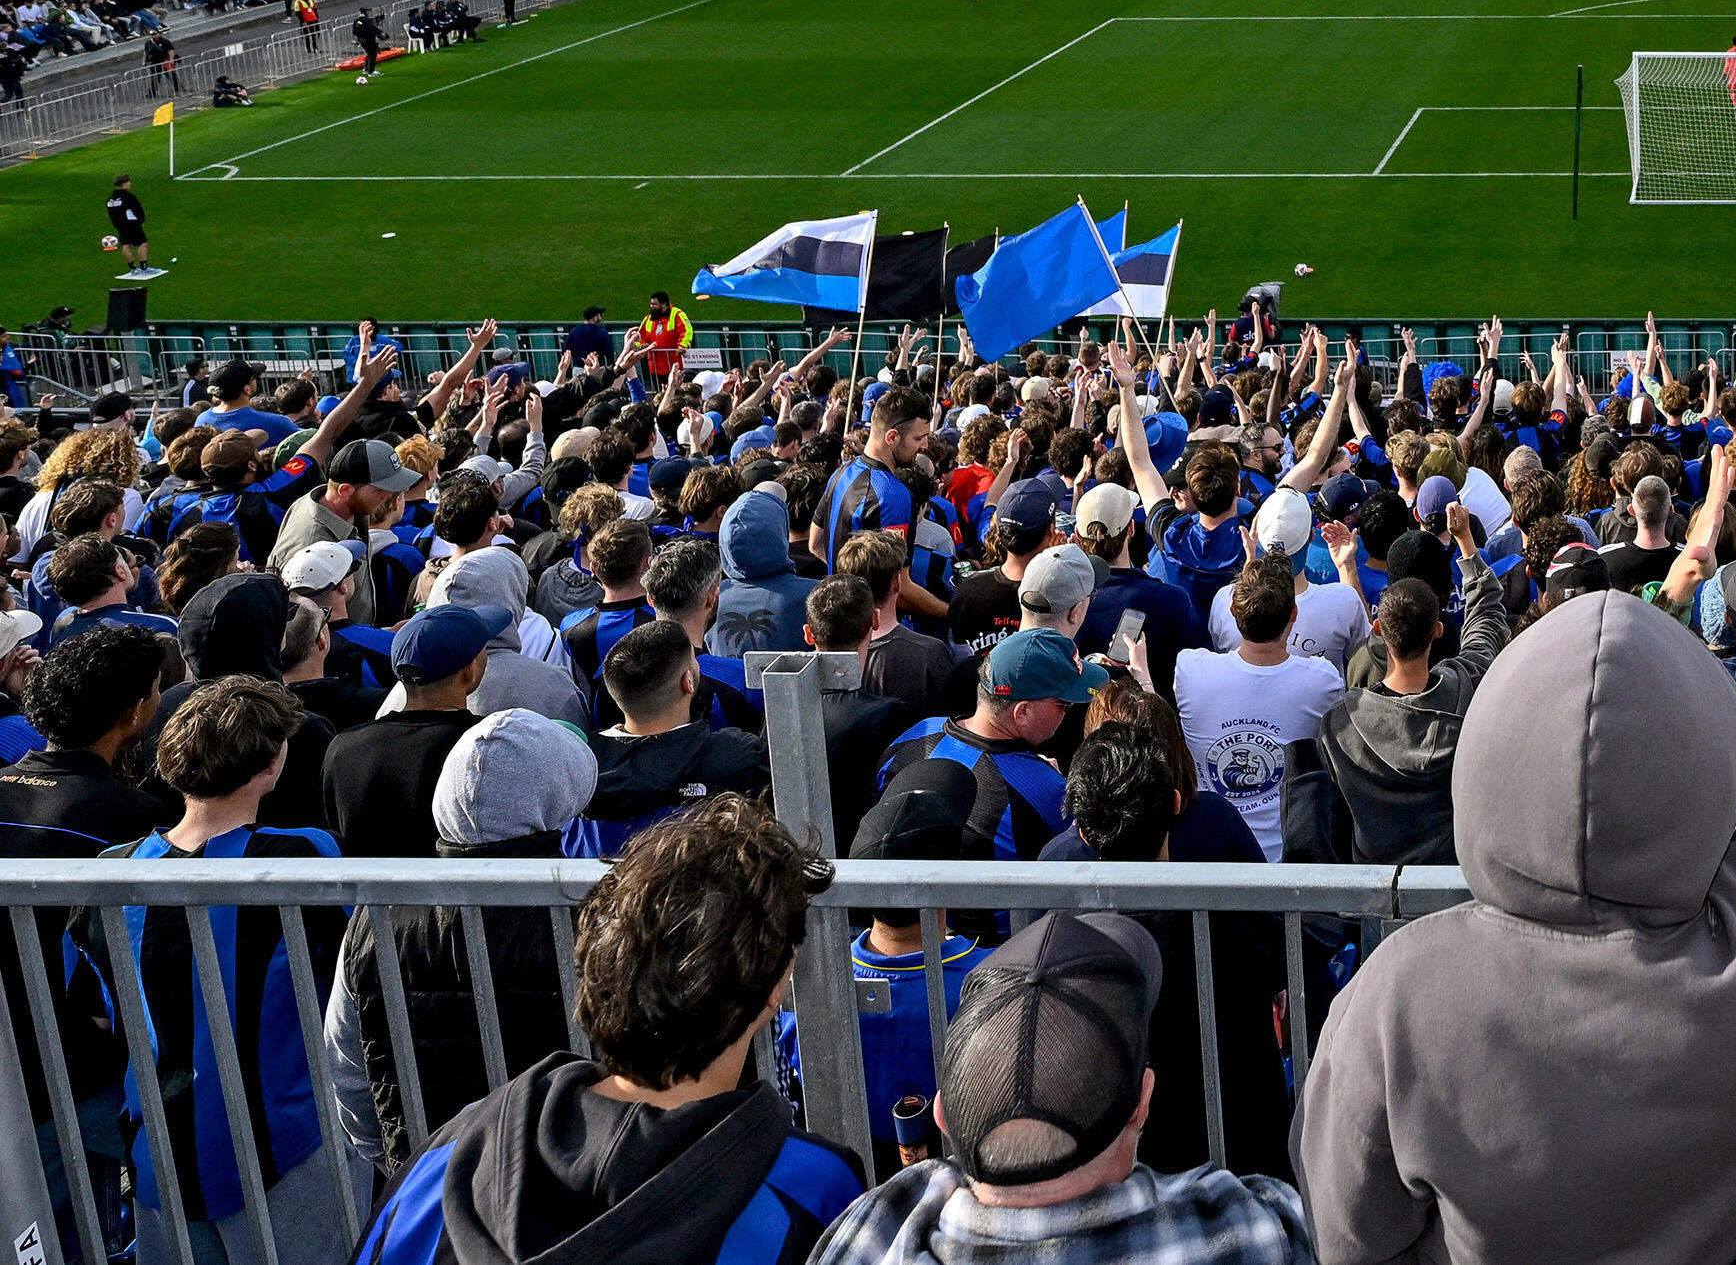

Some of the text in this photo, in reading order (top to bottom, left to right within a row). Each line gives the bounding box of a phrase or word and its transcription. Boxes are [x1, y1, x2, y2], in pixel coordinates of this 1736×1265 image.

[1243, 330, 1256, 342] sk
[1221, 718, 1281, 734] AUCKLAND FC
[1216, 733, 1279, 753] THE PORT
[17, 775, 58, 787] balance
[1225, 789, 1261, 798] EST 2024
